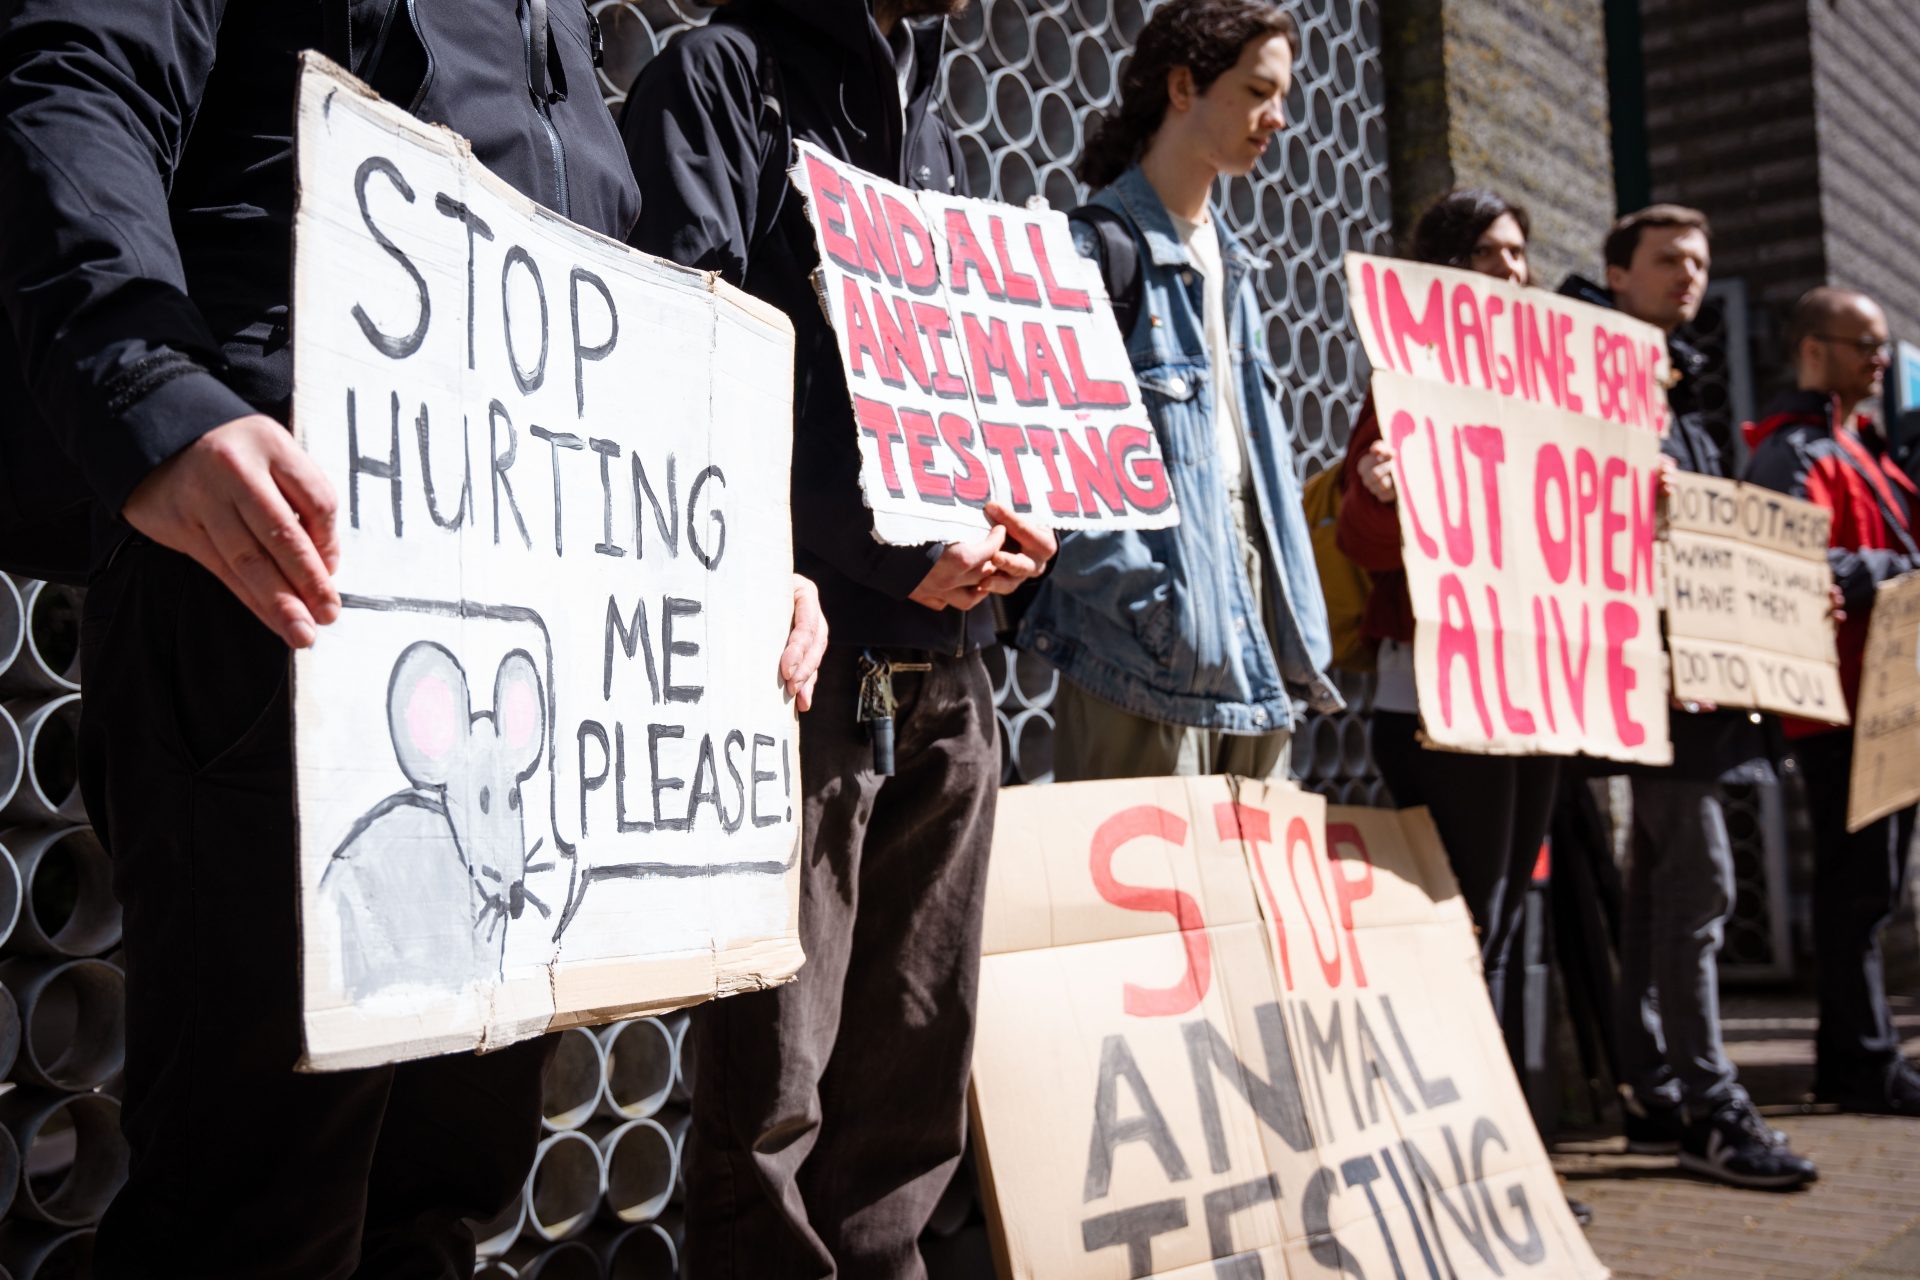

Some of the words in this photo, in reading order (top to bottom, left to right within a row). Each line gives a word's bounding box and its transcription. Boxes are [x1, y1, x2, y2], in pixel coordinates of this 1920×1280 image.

[351, 156, 619, 419] STOP
[804, 150, 942, 295] END
[943, 208, 1094, 314] ALL
[841, 275, 1131, 410] ANIMAL
[1361, 262, 1584, 414] IMAGINE
[1594, 323, 1668, 433] BEING
[347, 387, 726, 571] HURTING
[853, 393, 1174, 519] TESTING
[1391, 409, 1505, 571] CUT
[1535, 442, 1657, 596] OPEN
[1704, 489, 1738, 525] TO
[603, 593, 705, 705] ME
[1437, 572, 1646, 747] ALIVE
[1674, 575, 1736, 616] HAVE
[1678, 648, 1708, 684] DO
[1711, 652, 1750, 691] TO
[1758, 659, 1826, 706] YOU
[577, 719, 793, 840] PLEASE!
[1088, 801, 1375, 1017] STOP
[1083, 994, 1461, 1203] ANIMAL
